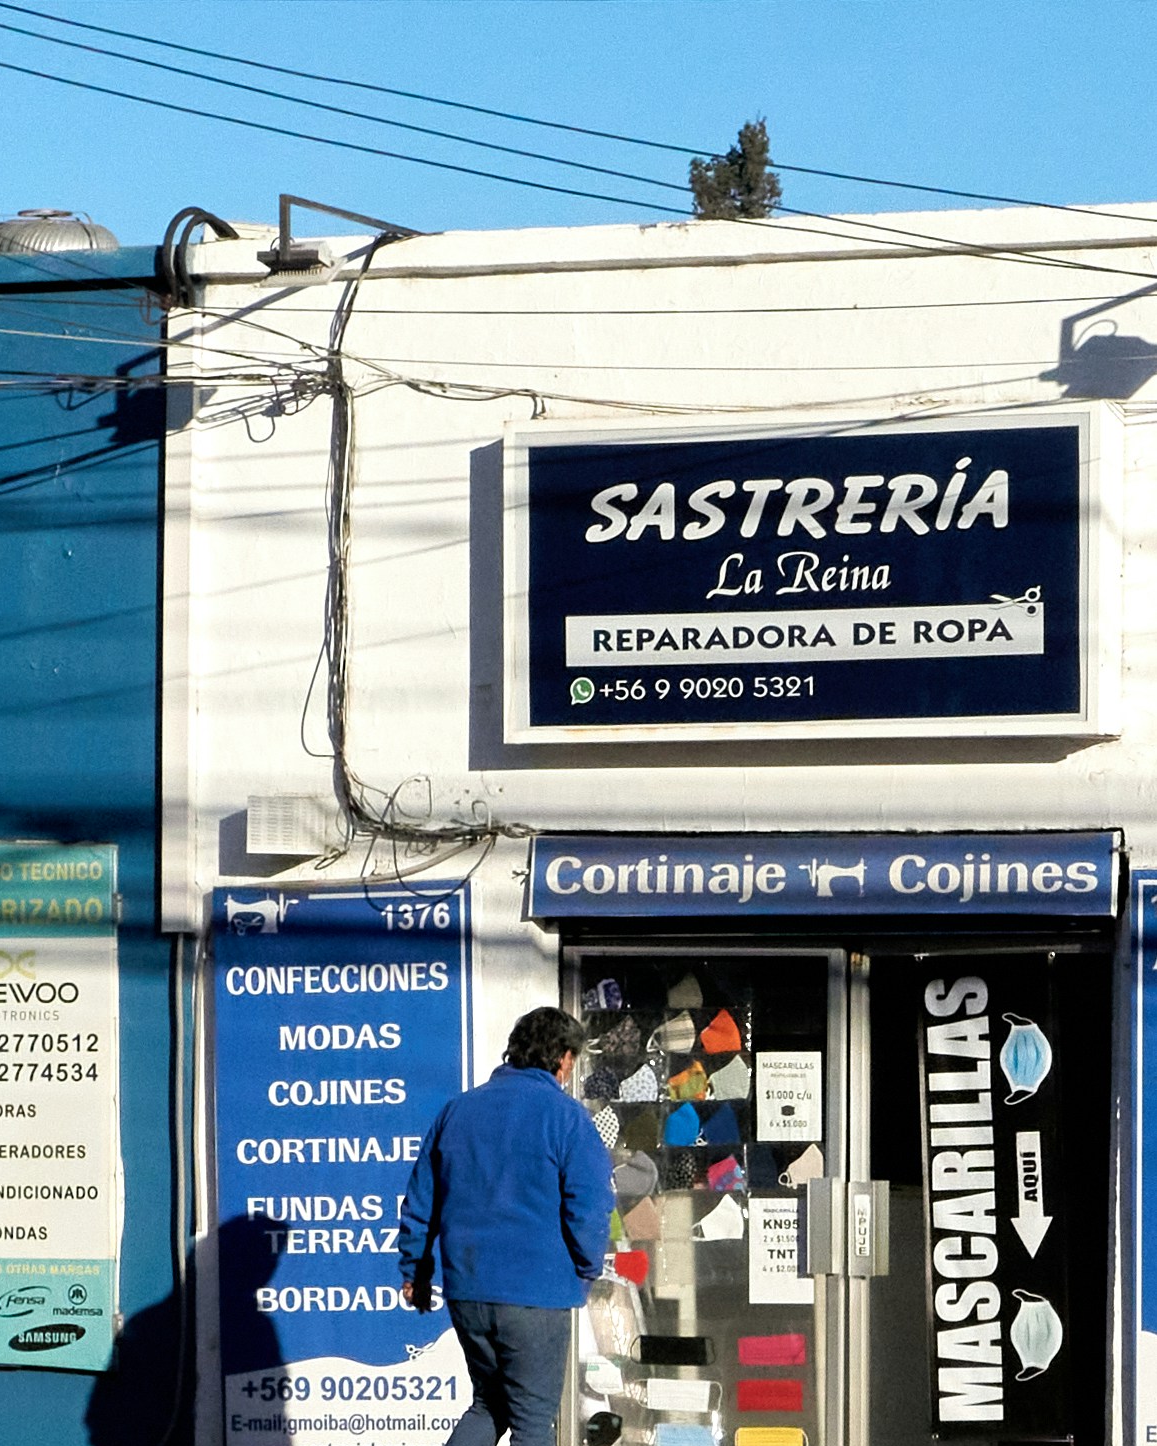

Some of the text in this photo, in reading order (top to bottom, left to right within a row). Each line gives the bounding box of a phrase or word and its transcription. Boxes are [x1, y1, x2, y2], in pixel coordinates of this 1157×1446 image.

[585, 456, 1009, 543] SASTRERÍA
[706, 551, 892, 599] La Reina
[593, 617, 1014, 652] REPARADORA DE ROPA
[599, 676, 814, 701] +56 9 9020 5321
[21, 862, 102, 881] TECNICO
[544, 852, 1099, 903] Cortinaje Cojines
[381, 902, 451, 930] 1376
[226, 961, 449, 996] CONFECCIONES
[279, 1024, 401, 1050] MODAS
[268, 1079, 406, 1106] COJINES
[1020, 1151, 1039, 1202] AQUÍ
[247, 1195, 383, 1222] FUNDAS
[924, 975, 1004, 1422] MASCARILLAS
[763, 1219, 800, 1230] KN95
[858, 1208, 867, 1254] MPUJE
[265, 1228, 400, 1254] TERRAZ
[776, 1235, 799, 1243] $1.50
[767, 1249, 795, 1260] TNT
[776, 1265, 797, 1273] $2.00
[53, 1306, 103, 1316] mademsa
[18, 1331, 77, 1343] SAMSUNG
[242, 1375, 458, 1402] +569 90205321
